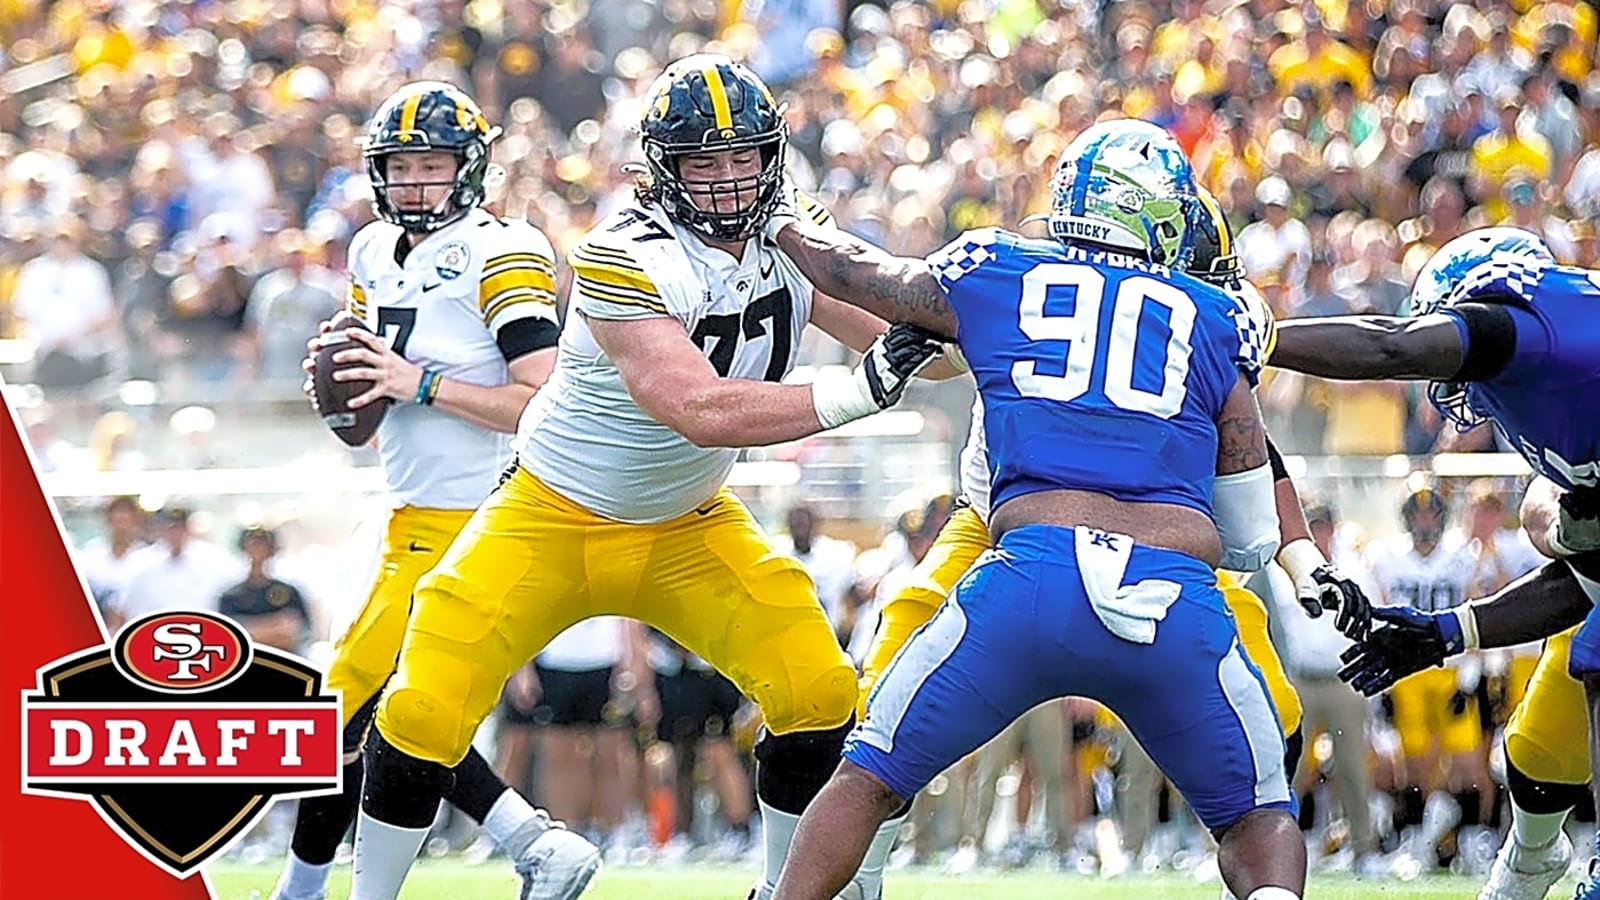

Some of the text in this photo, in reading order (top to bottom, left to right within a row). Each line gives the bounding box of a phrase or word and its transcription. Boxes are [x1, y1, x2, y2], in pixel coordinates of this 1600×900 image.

[1052, 220, 1111, 241] KENTUCKY
[376, 306, 418, 358] 7
[690, 286, 792, 383] 77
[1010, 263, 1199, 420] 90
